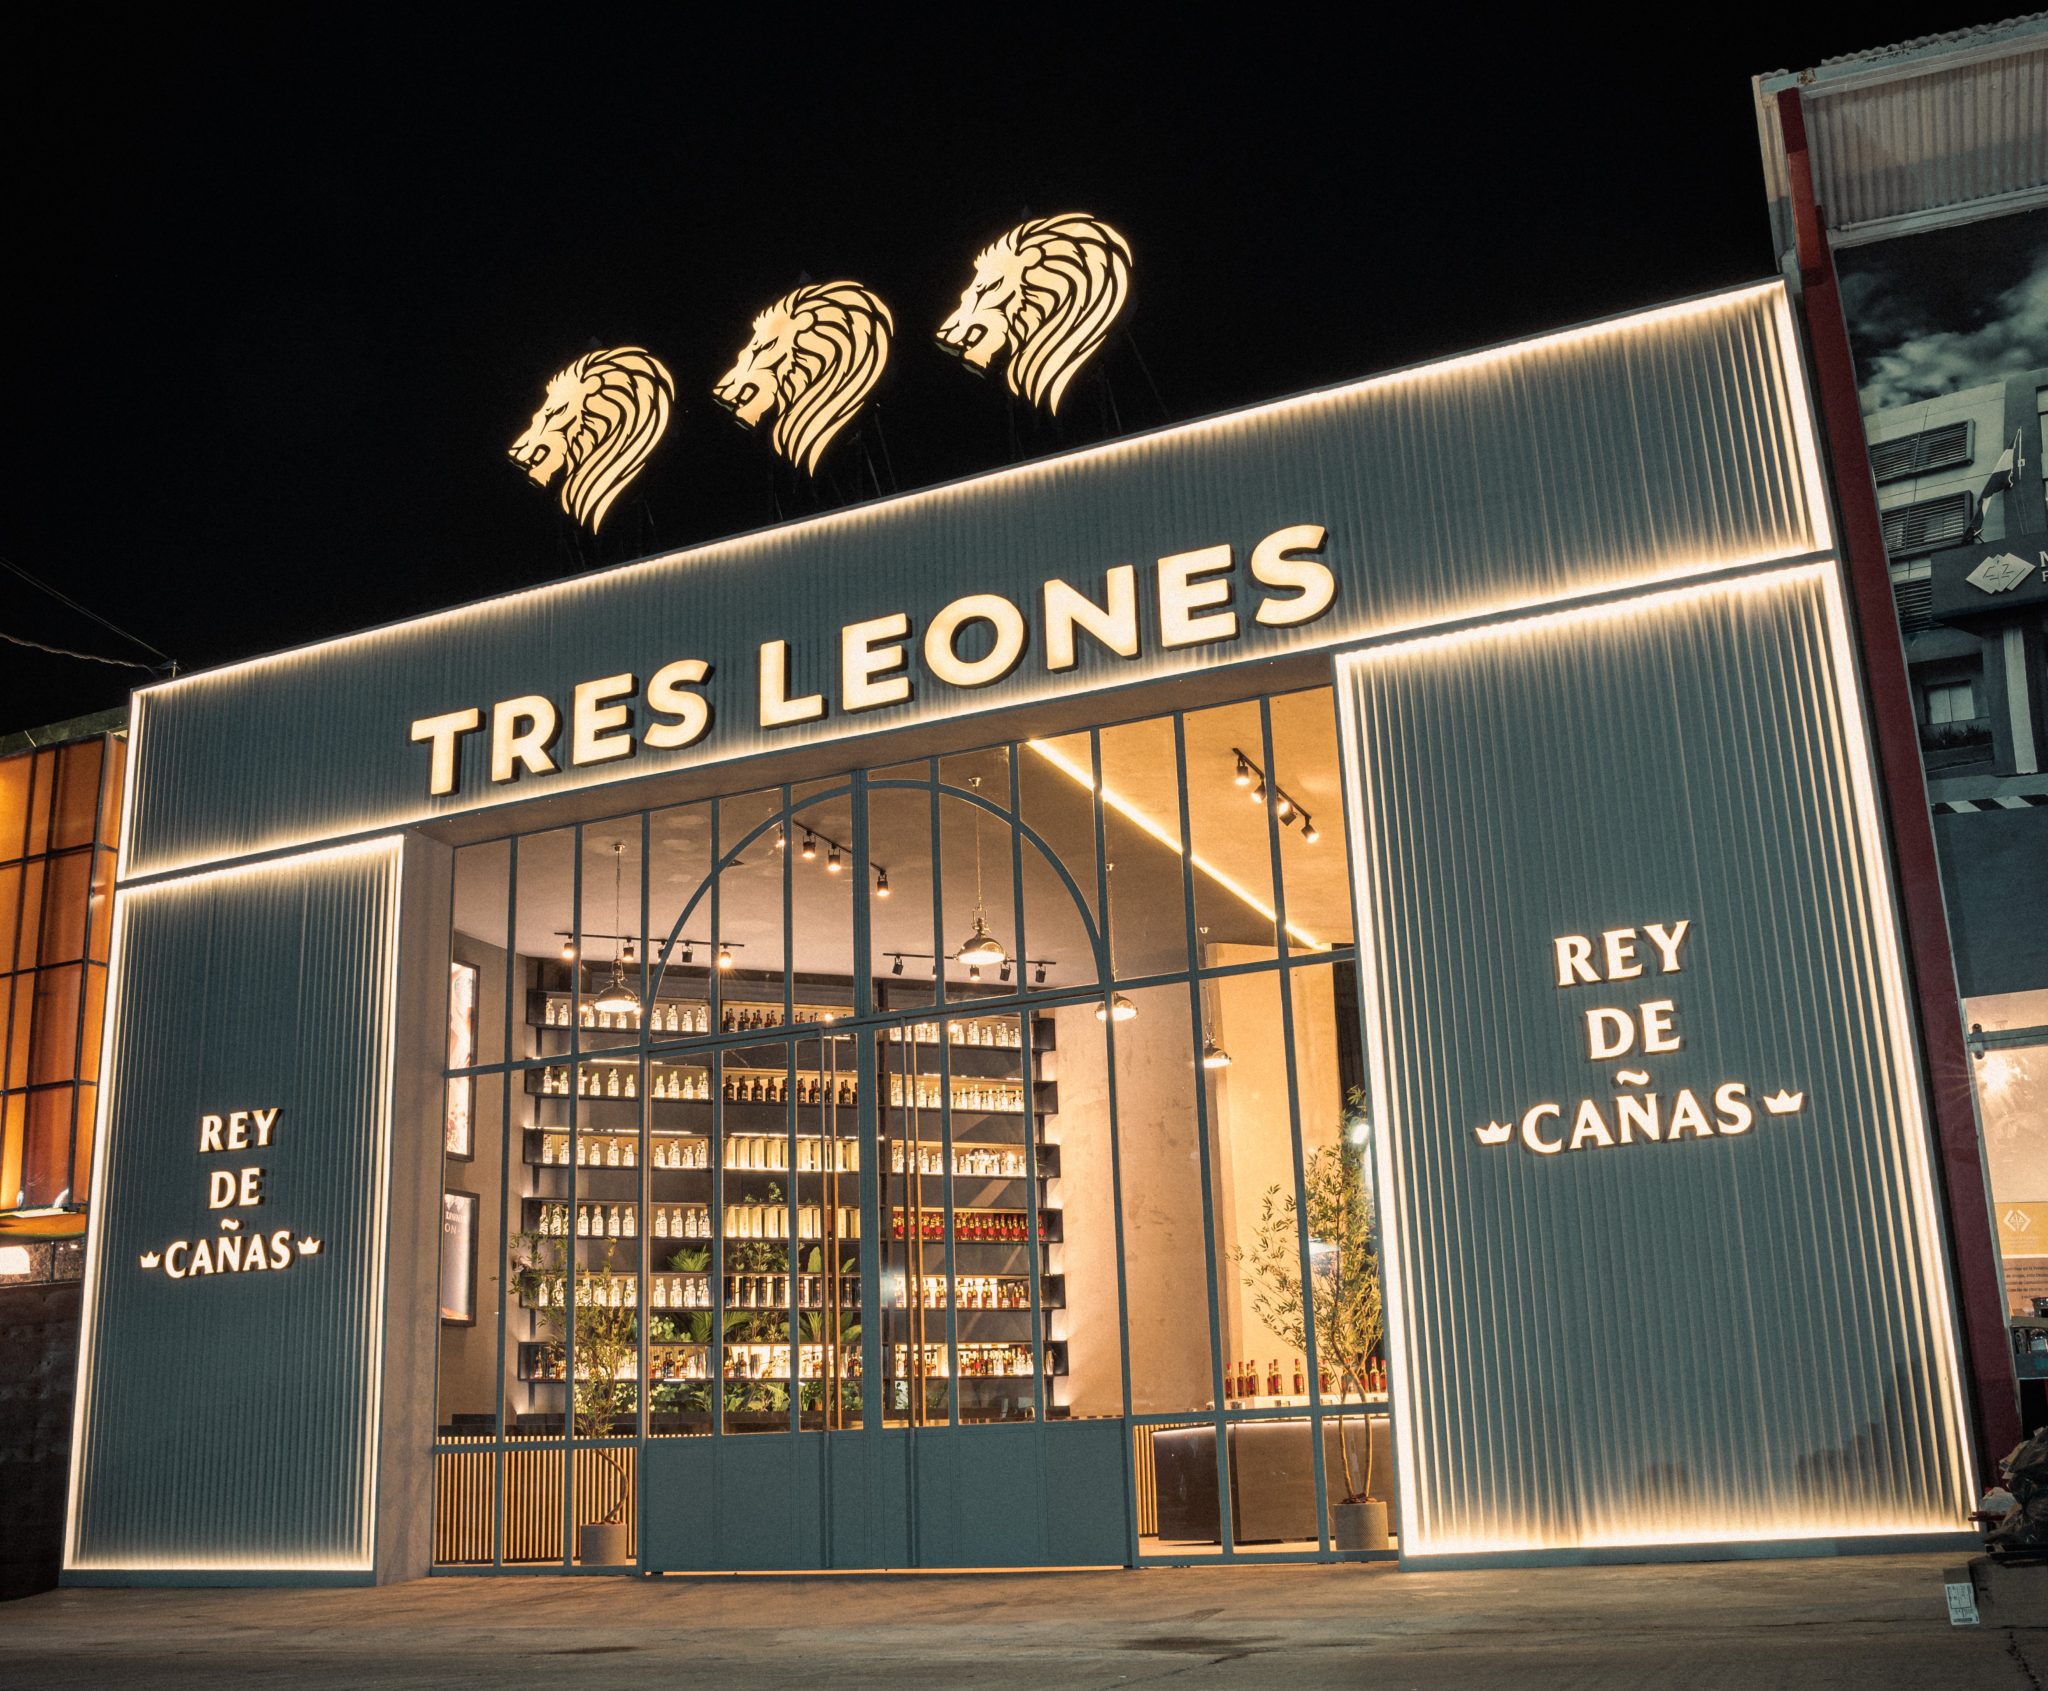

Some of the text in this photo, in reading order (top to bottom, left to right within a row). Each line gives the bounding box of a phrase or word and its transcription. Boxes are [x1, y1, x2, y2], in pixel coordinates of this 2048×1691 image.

[411, 524, 1336, 796] TRES LEONES
[1554, 920, 1691, 987] REY
[1585, 1000, 1680, 1060] DE
[200, 1107, 279, 1152] REY
[1521, 1070, 1752, 1154] CAÑAS
[209, 1167, 261, 1209] DE
[165, 1218, 292, 1279] CAÑAS
